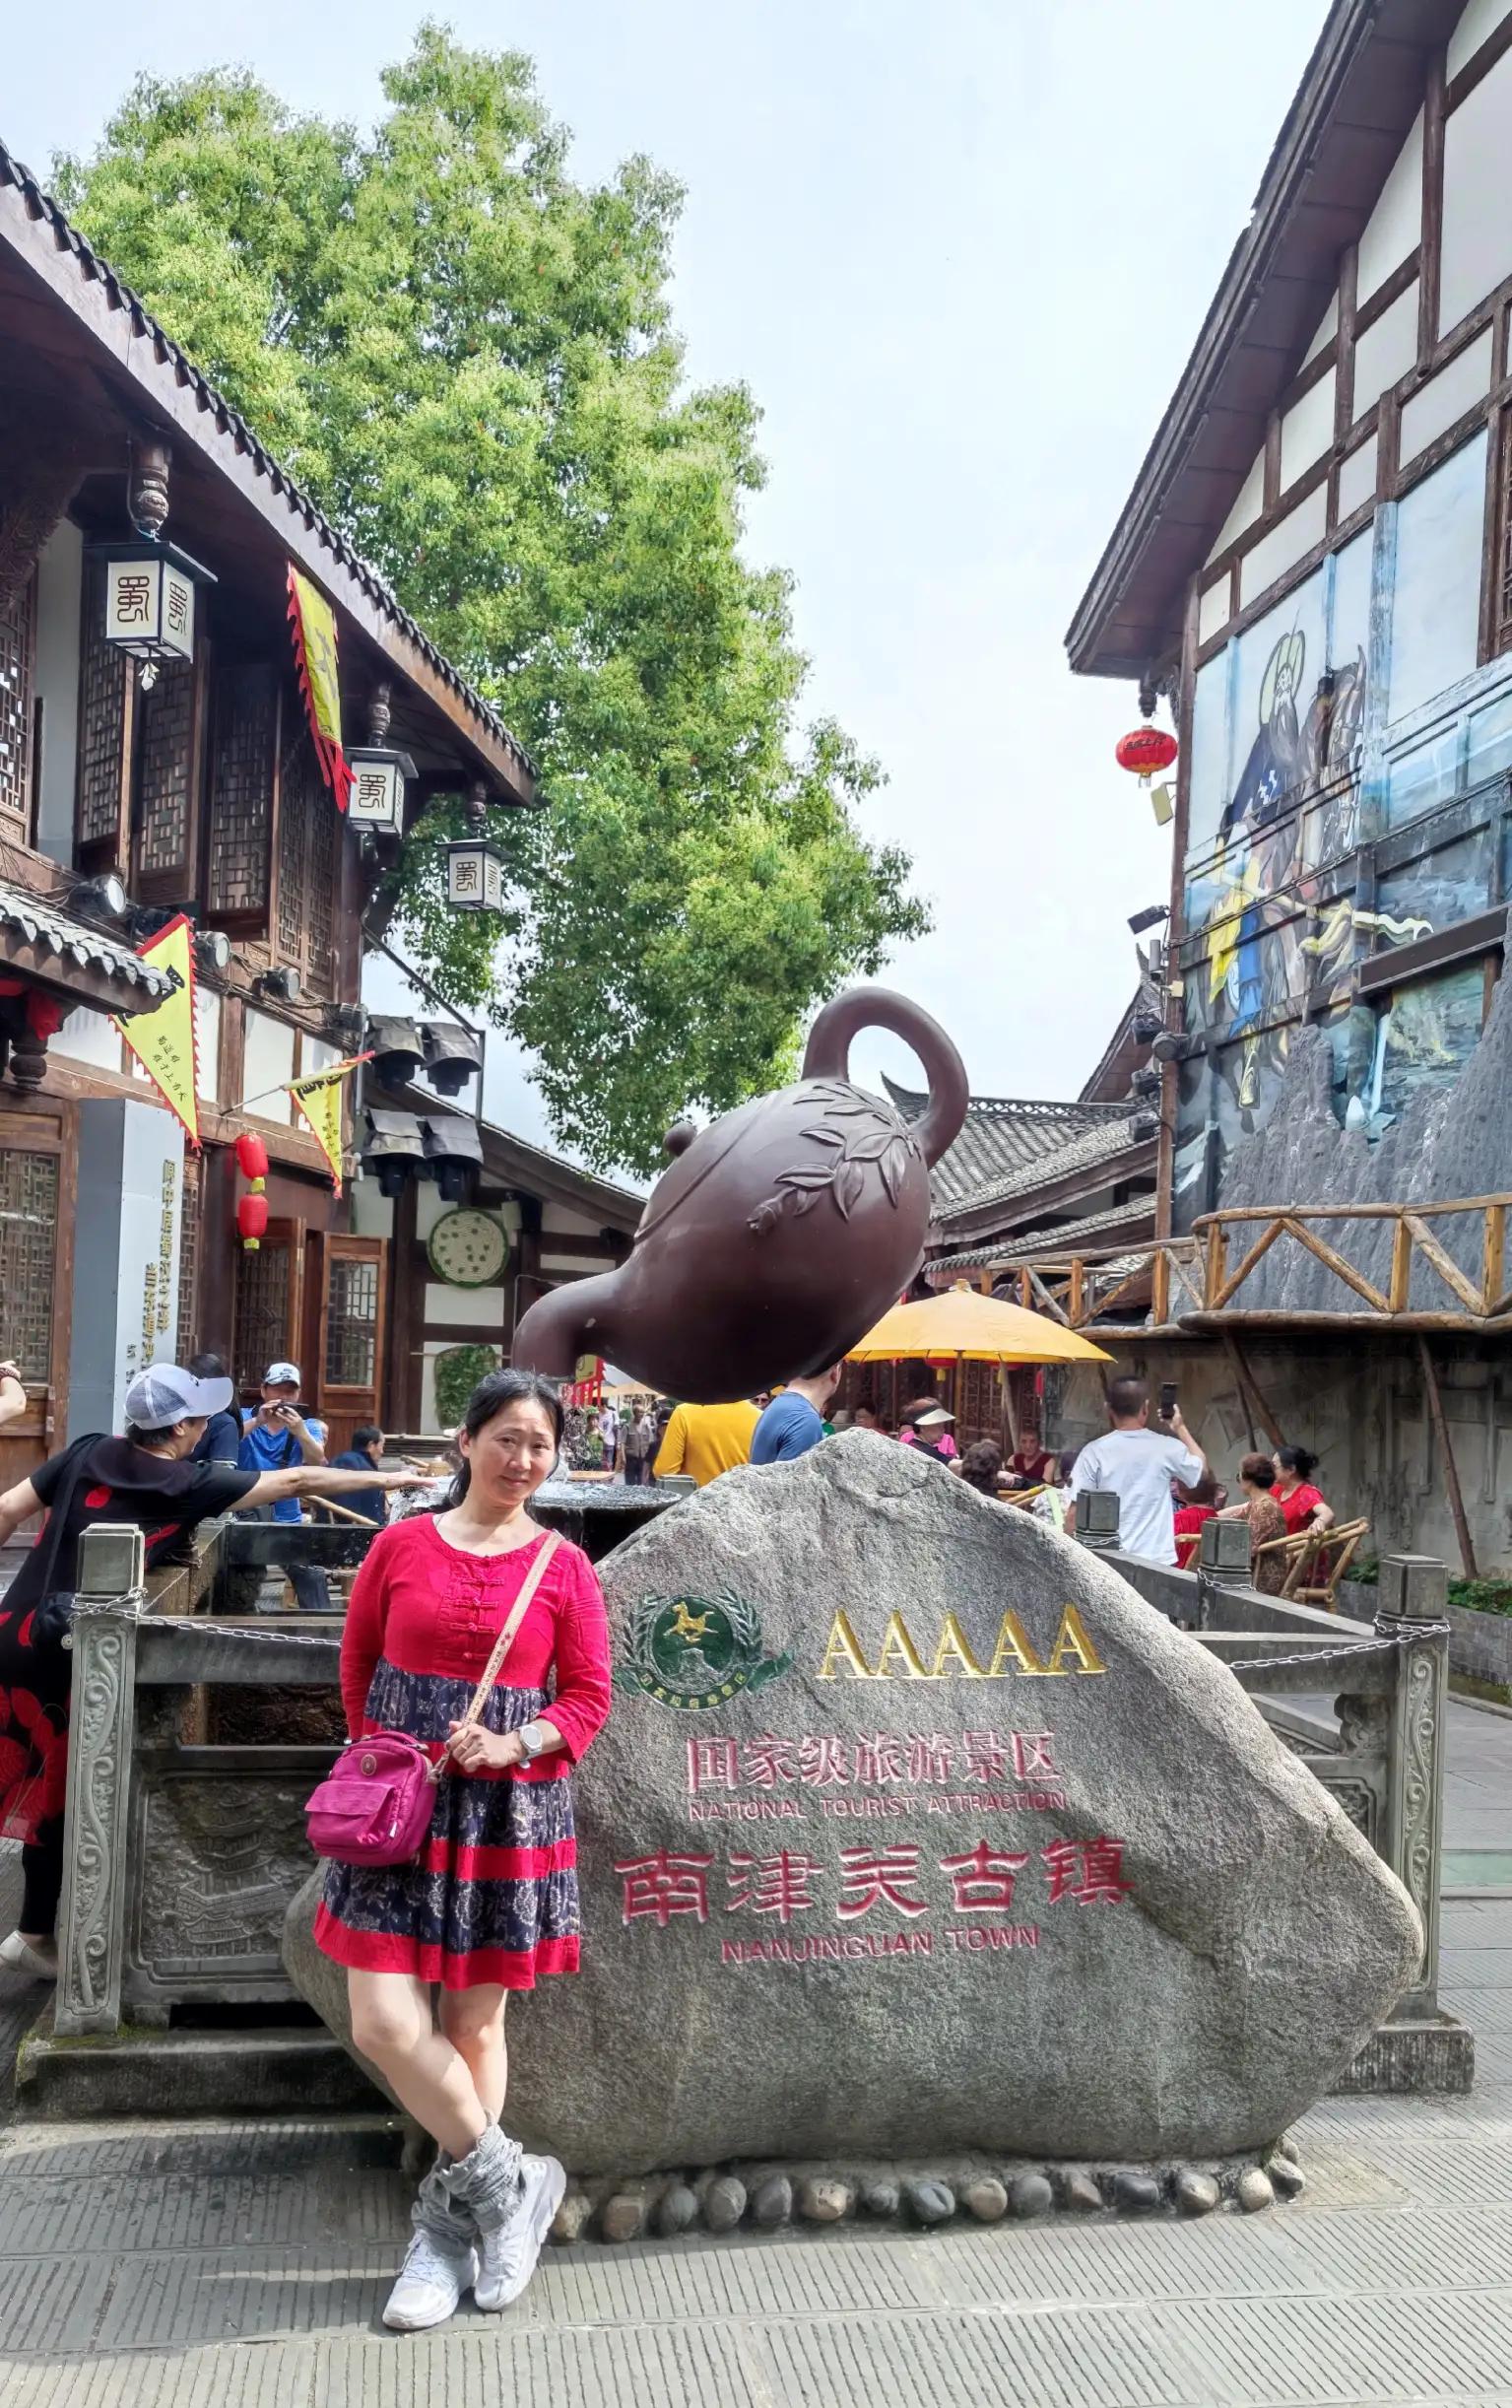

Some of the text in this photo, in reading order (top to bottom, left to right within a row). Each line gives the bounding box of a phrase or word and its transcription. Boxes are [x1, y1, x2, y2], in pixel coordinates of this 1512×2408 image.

[815, 1602, 1110, 1679] AAAAA
[687, 1729, 1063, 1793] 国家级旅游景区
[690, 1791, 1068, 1821] NATIONAL TOURIST ATTRACTION
[614, 1837, 1137, 1927] 南津关古镇
[722, 1925, 1039, 1964] NANJINGUAN TOWN
